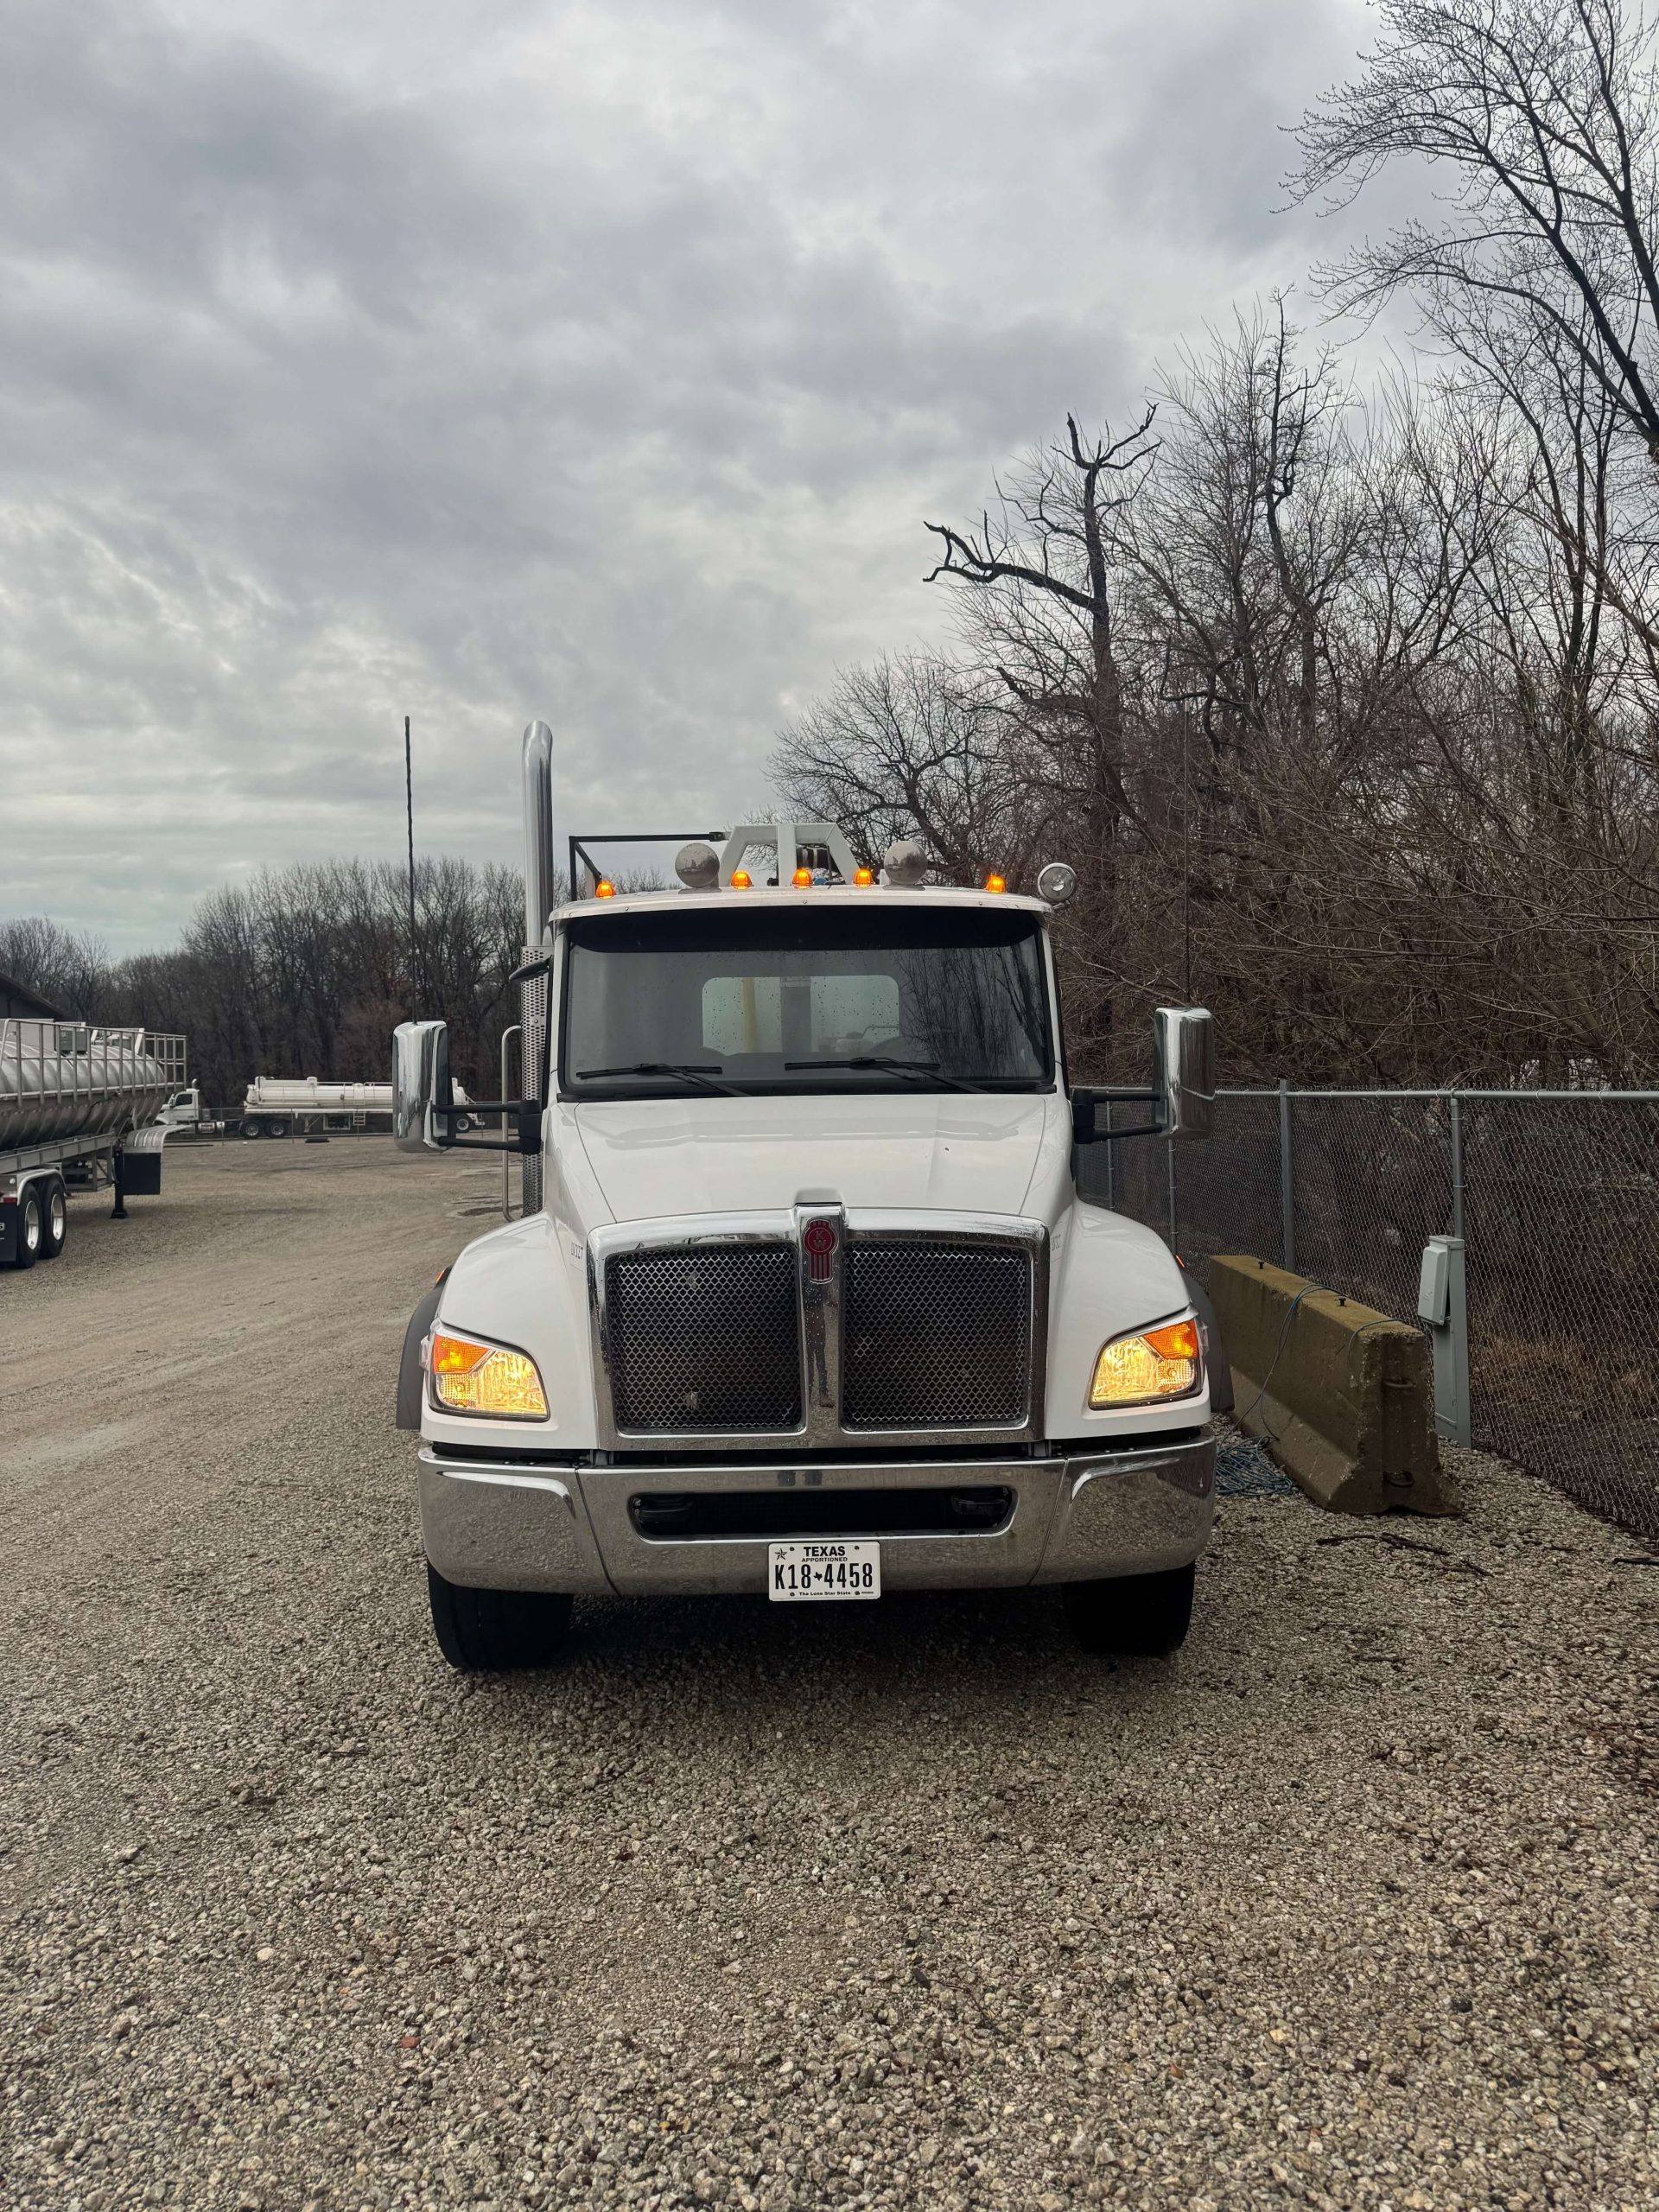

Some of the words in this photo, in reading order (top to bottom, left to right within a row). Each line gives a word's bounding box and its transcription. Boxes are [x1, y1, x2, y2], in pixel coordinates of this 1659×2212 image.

[803, 1546, 846, 1557] TEXAS
[774, 1564, 811, 1590] K18
[823, 1562, 873, 1589] 4458
